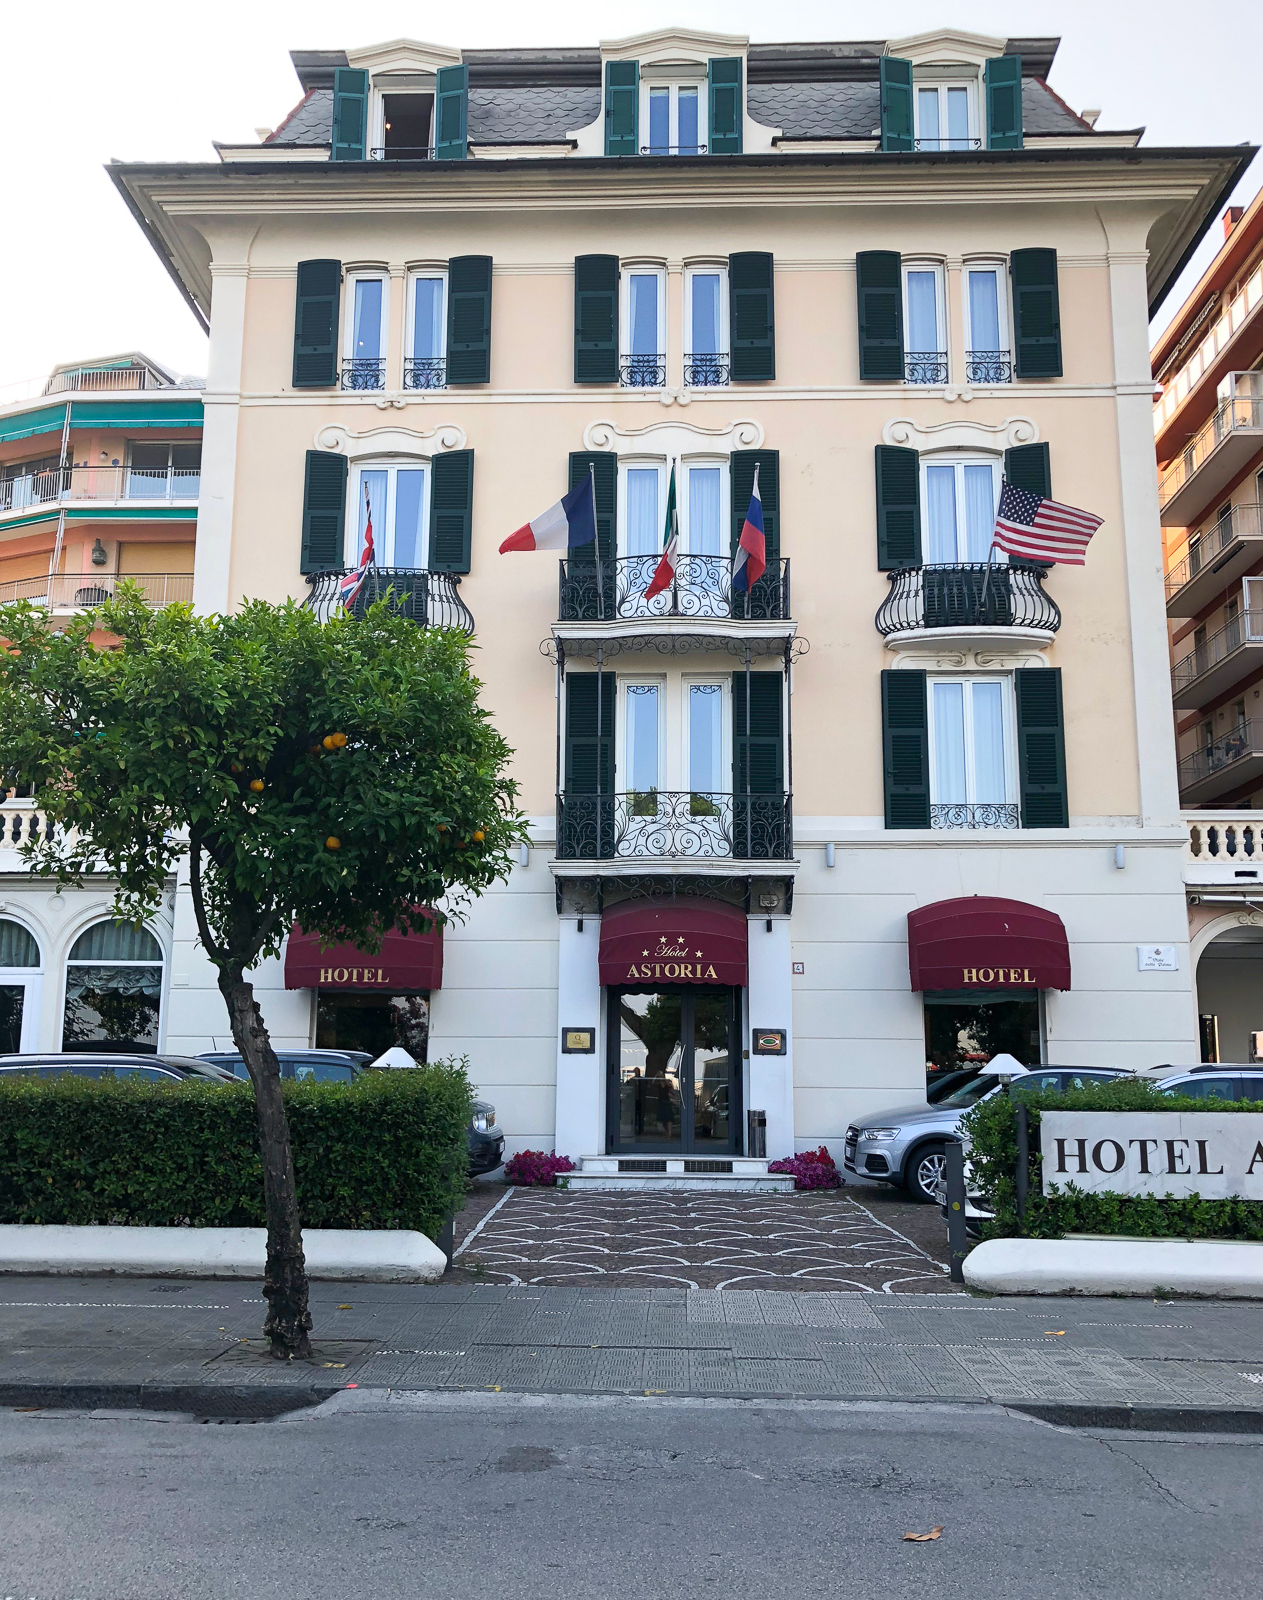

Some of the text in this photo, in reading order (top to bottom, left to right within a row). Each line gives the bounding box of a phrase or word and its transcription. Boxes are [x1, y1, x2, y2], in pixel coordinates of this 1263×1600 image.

[654, 944, 689, 957] Hotel
[319, 967, 390, 983] HOTEL
[626, 963, 718, 979] ASTORIA
[962, 968, 1036, 983] HOTEL
[1053, 1138, 1224, 1175] HOTEL
